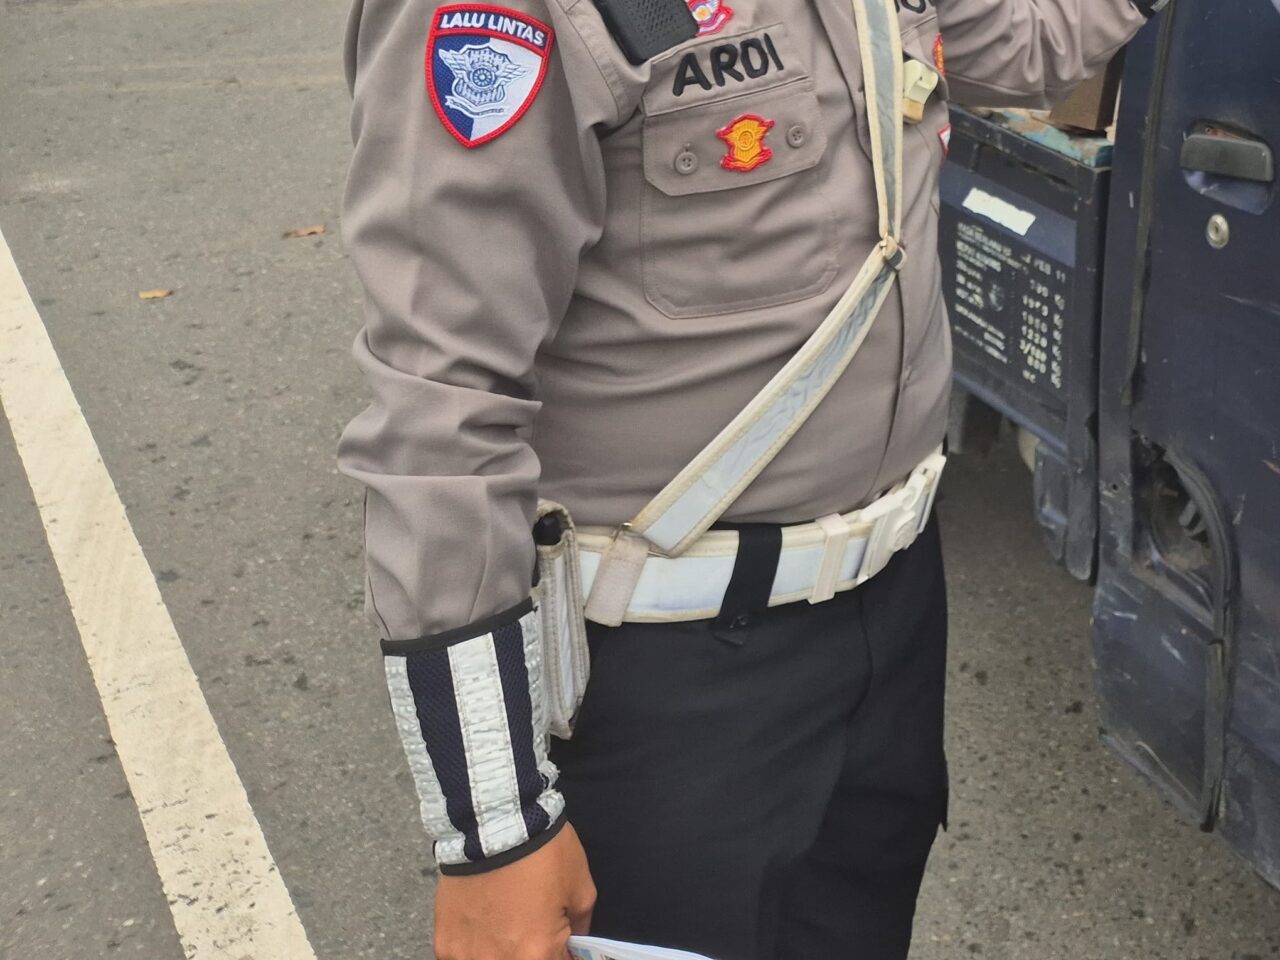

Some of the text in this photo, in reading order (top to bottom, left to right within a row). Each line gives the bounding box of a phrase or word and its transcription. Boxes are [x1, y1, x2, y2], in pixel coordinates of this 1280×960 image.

[440, 12, 546, 47] LALU LINTAS
[672, 32, 785, 97] ARDI
